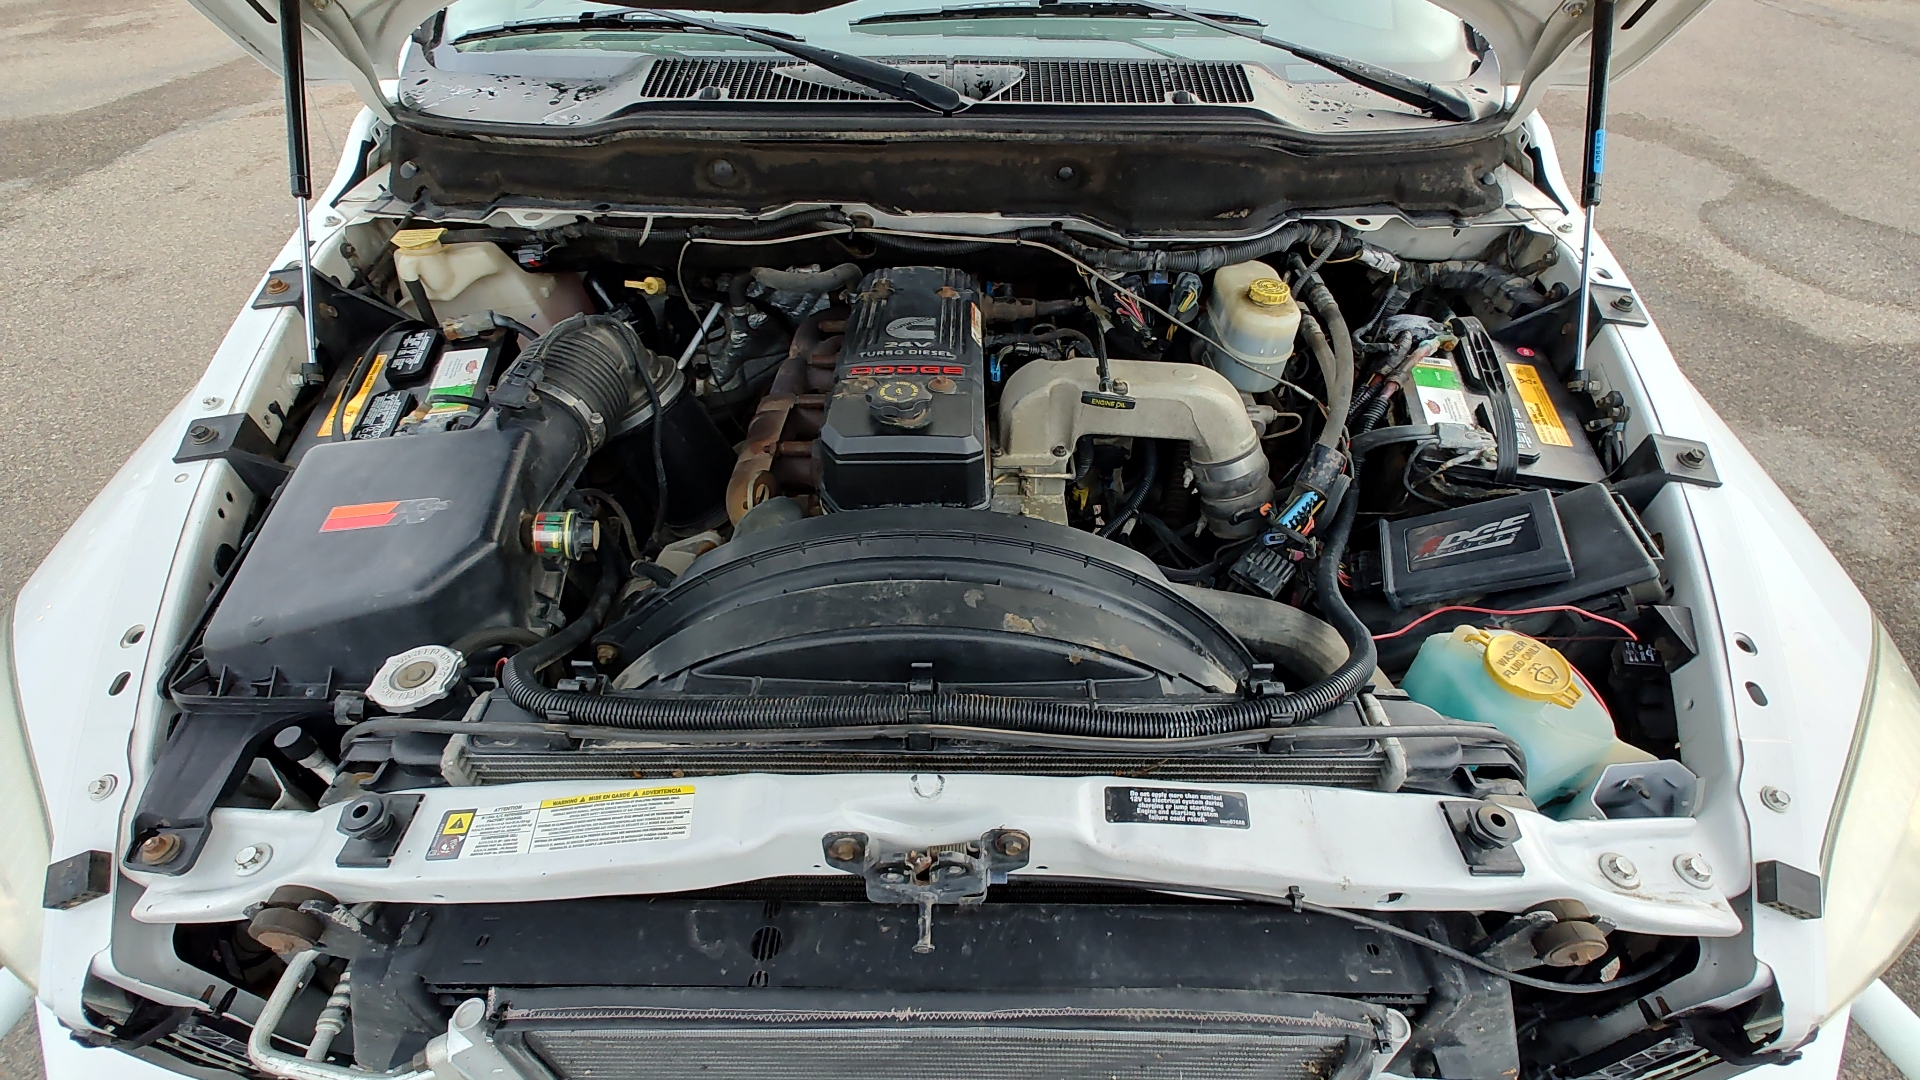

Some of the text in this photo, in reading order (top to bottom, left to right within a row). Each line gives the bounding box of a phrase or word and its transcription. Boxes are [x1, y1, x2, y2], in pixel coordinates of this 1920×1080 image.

[851, 366, 964, 375] DODGE
[1091, 398, 1115, 407] ENGINE
[1412, 533, 1517, 560] PRODUCTS
[1496, 640, 1527, 667] WASHER
[1502, 644, 1541, 679] FLUID ONLY
[552, 797, 578, 806] WARNING
[641, 788, 682, 796] ADVERTENCIA
